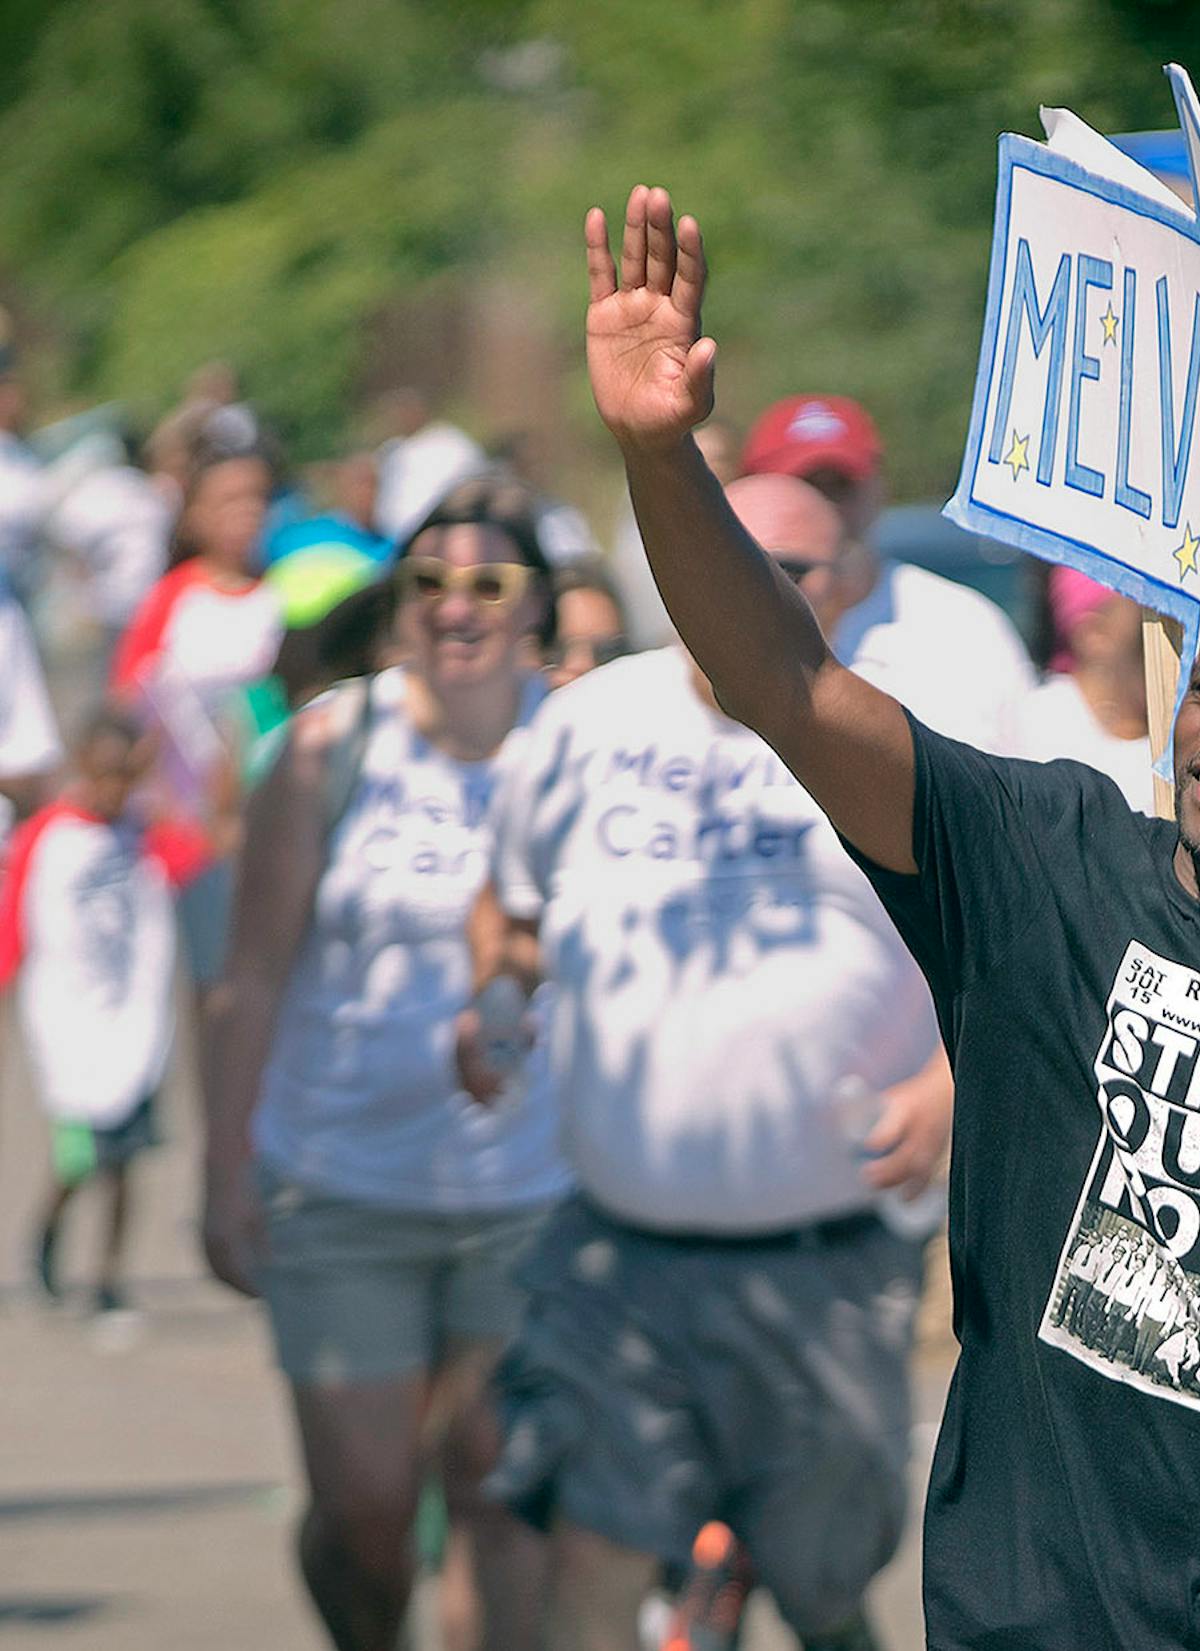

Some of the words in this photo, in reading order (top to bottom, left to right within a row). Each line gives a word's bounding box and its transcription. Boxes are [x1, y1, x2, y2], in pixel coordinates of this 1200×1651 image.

[1131, 958, 1167, 983] SAT
[1125, 972, 1162, 997] JUL
[1131, 987, 1153, 1005] 15
